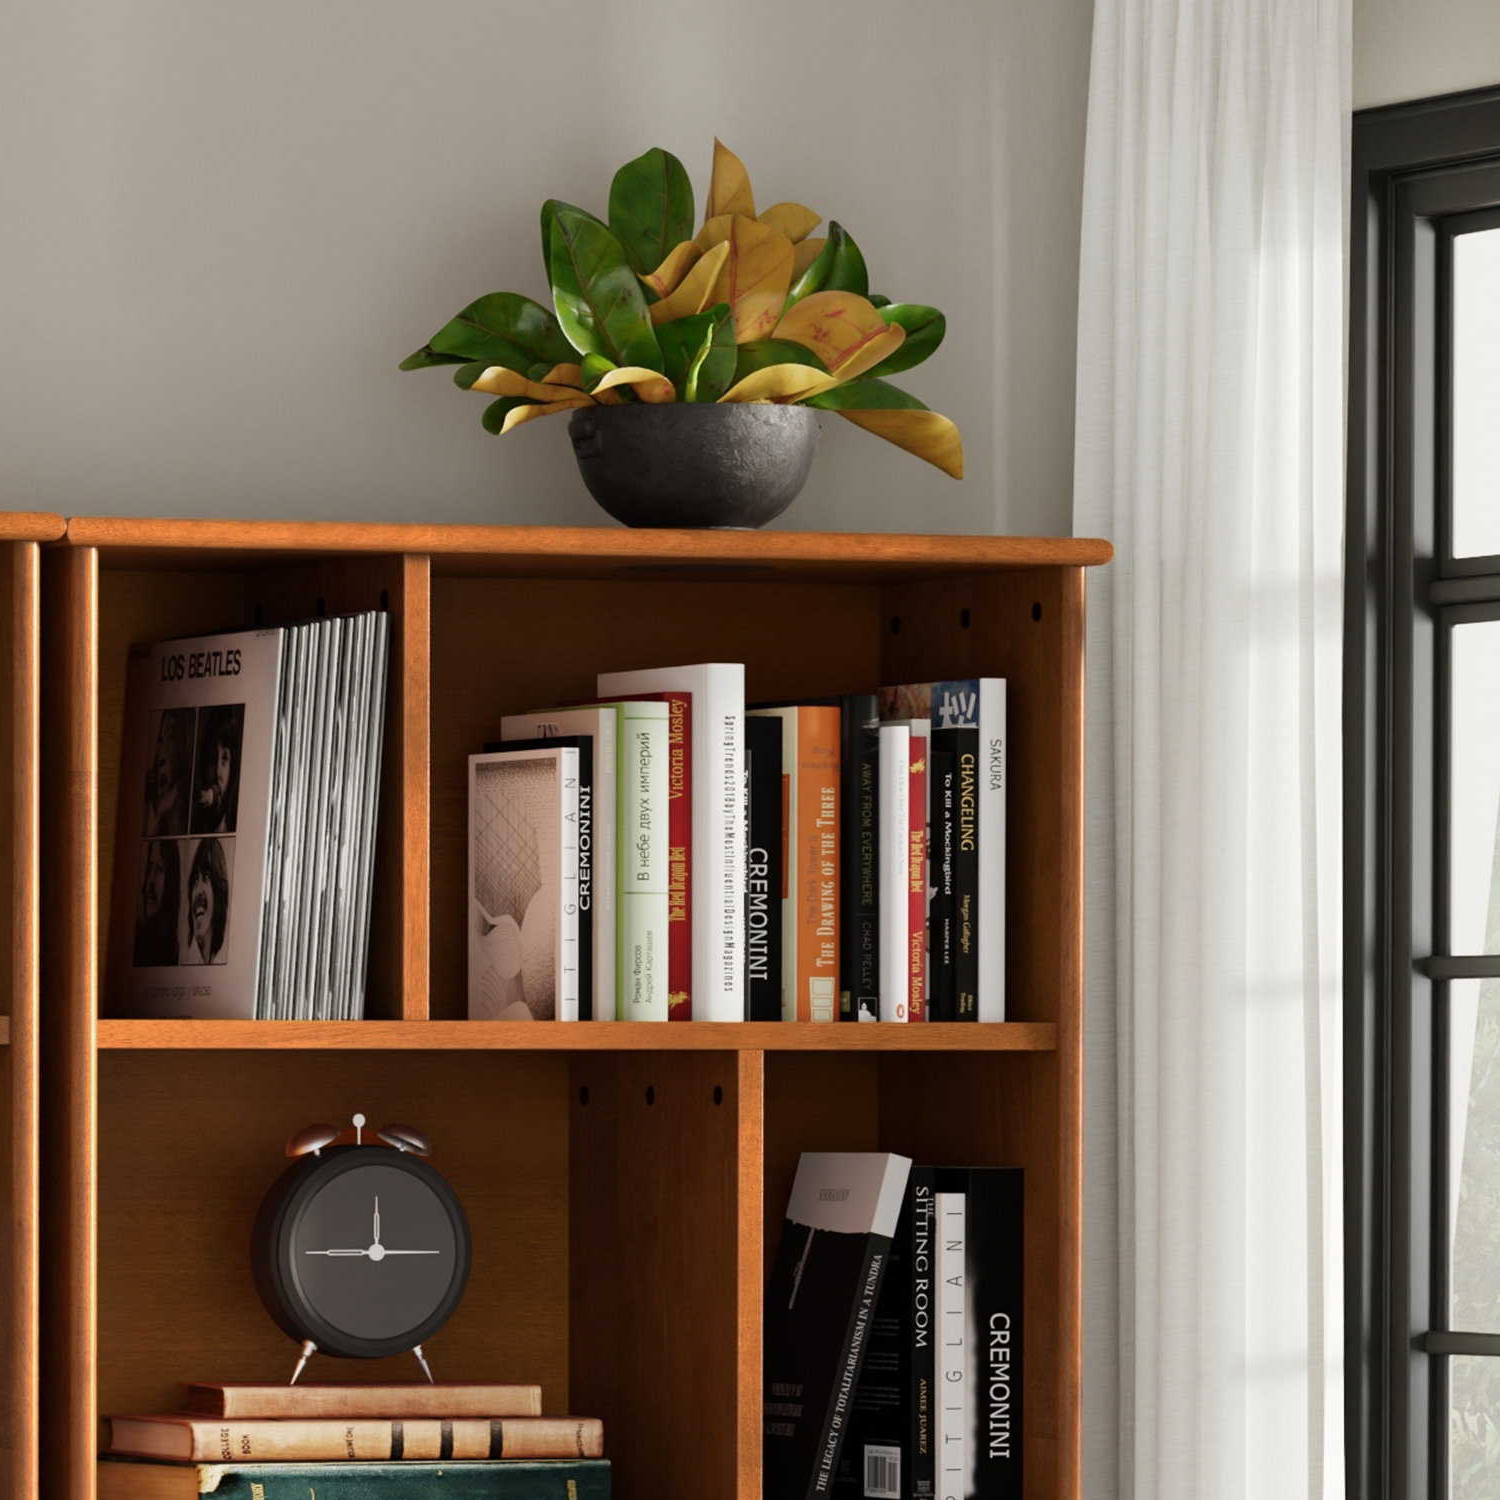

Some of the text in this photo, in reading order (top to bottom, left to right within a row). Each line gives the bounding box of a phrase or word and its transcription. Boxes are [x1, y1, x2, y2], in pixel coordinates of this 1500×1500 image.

[160, 649, 242, 682] LOS BEATLES
[636, 732, 652, 793] империй
[668, 698, 687, 799] Victoria Mosley
[945, 773, 952, 788] To
[989, 738, 1002, 791] SAKURA
[639, 798, 652, 830] двух
[816, 787, 835, 828] THREE
[862, 763, 872, 906] AWAY FROM EVERYWHERE
[960, 753, 975, 851] CHANGELING
[579, 785, 591, 911] CREMONINI
[636, 834, 650, 867] небе
[943, 821, 952, 895] Mockingbird
[749, 847, 768, 980] CREMONINI
[816, 881, 835, 937] DRAWING
[961, 894, 971, 954] Morgan Gallagher
[862, 921, 872, 990] CHAD PELLEY
[909, 930, 924, 1015] Victoria Mosley
[915, 1186, 929, 1348] SITTING ROOM
[816, 1254, 883, 1493] THE LEGACY OF TOTALITARIANISM IN A TUNDRA
[989, 1312, 1010, 1459] CREMONINI
[220, 1428, 231, 1460] COLLEGE
[241, 1434, 251, 1455] BOOK
[918, 1378, 928, 1455] AIMEE JUAREZ
